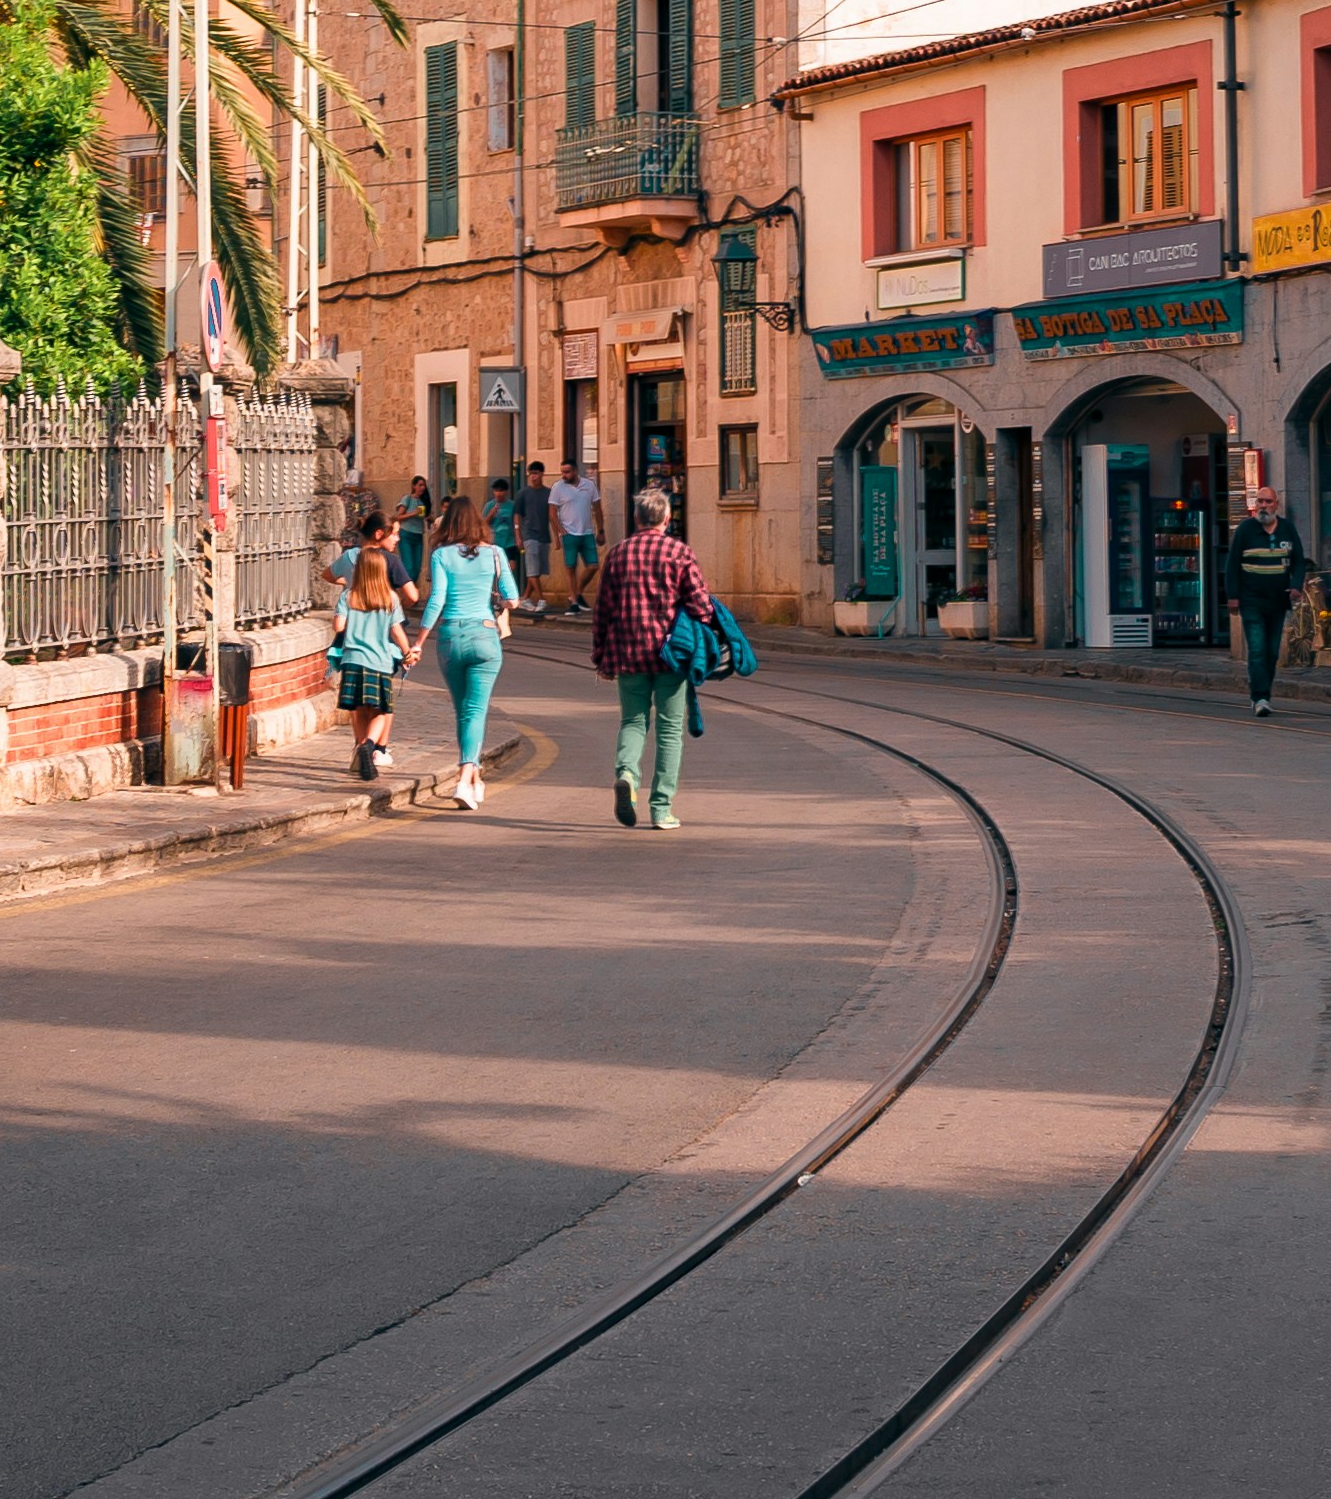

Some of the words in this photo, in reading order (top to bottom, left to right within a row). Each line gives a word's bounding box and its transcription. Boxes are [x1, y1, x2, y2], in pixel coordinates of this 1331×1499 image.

[1131, 242, 1199, 266] ARQUITECTOS
[1014, 317, 1038, 340] SA
[1039, 311, 1106, 338] BOTIGA
[1106, 308, 1135, 332] DE
[1135, 306, 1162, 329] SA
[1163, 299, 1229, 331] PLAÇA
[829, 327, 960, 361] MARKET
